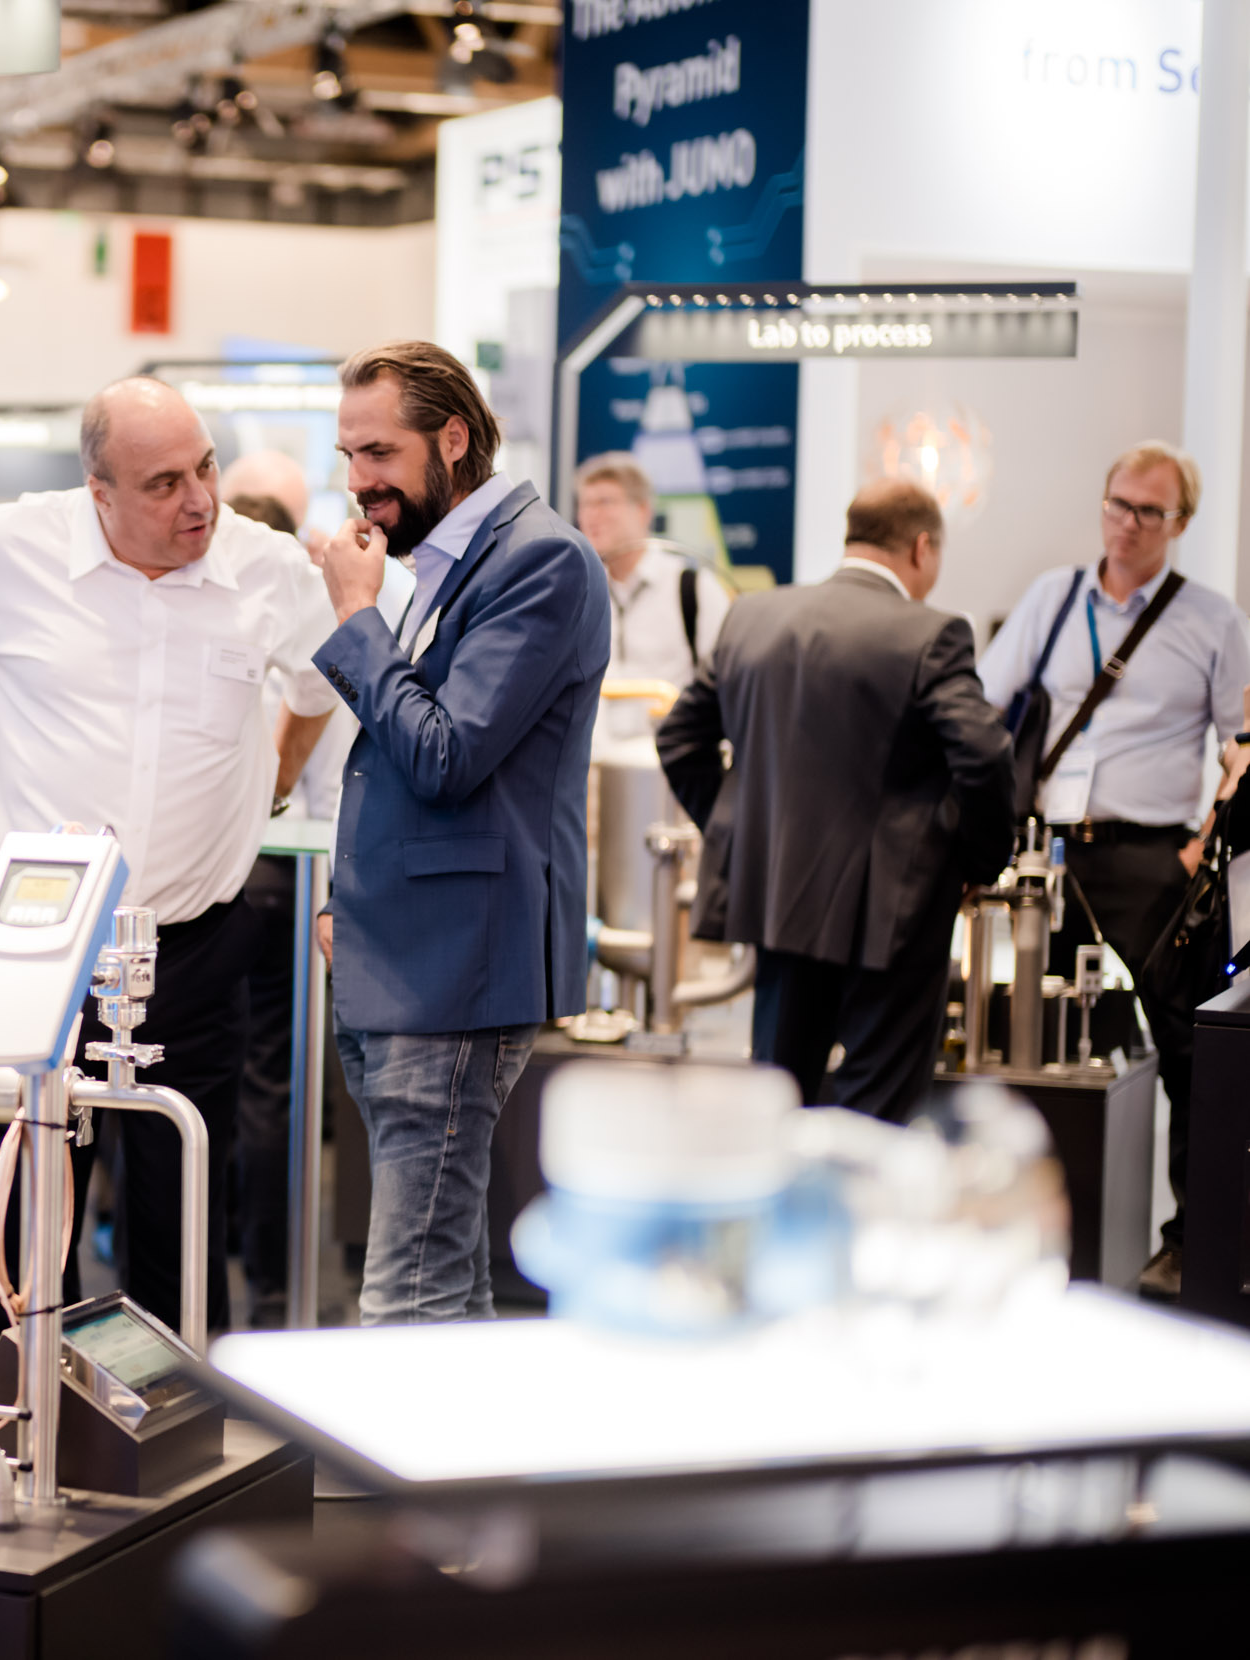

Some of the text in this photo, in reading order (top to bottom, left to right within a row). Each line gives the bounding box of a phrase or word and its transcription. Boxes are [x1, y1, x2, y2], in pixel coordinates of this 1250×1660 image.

[613, 33, 742, 128] Pyramid
[1021, 35, 1139, 90] from
[596, 149, 664, 214] with
[748, 318, 932, 354] Lab to process
